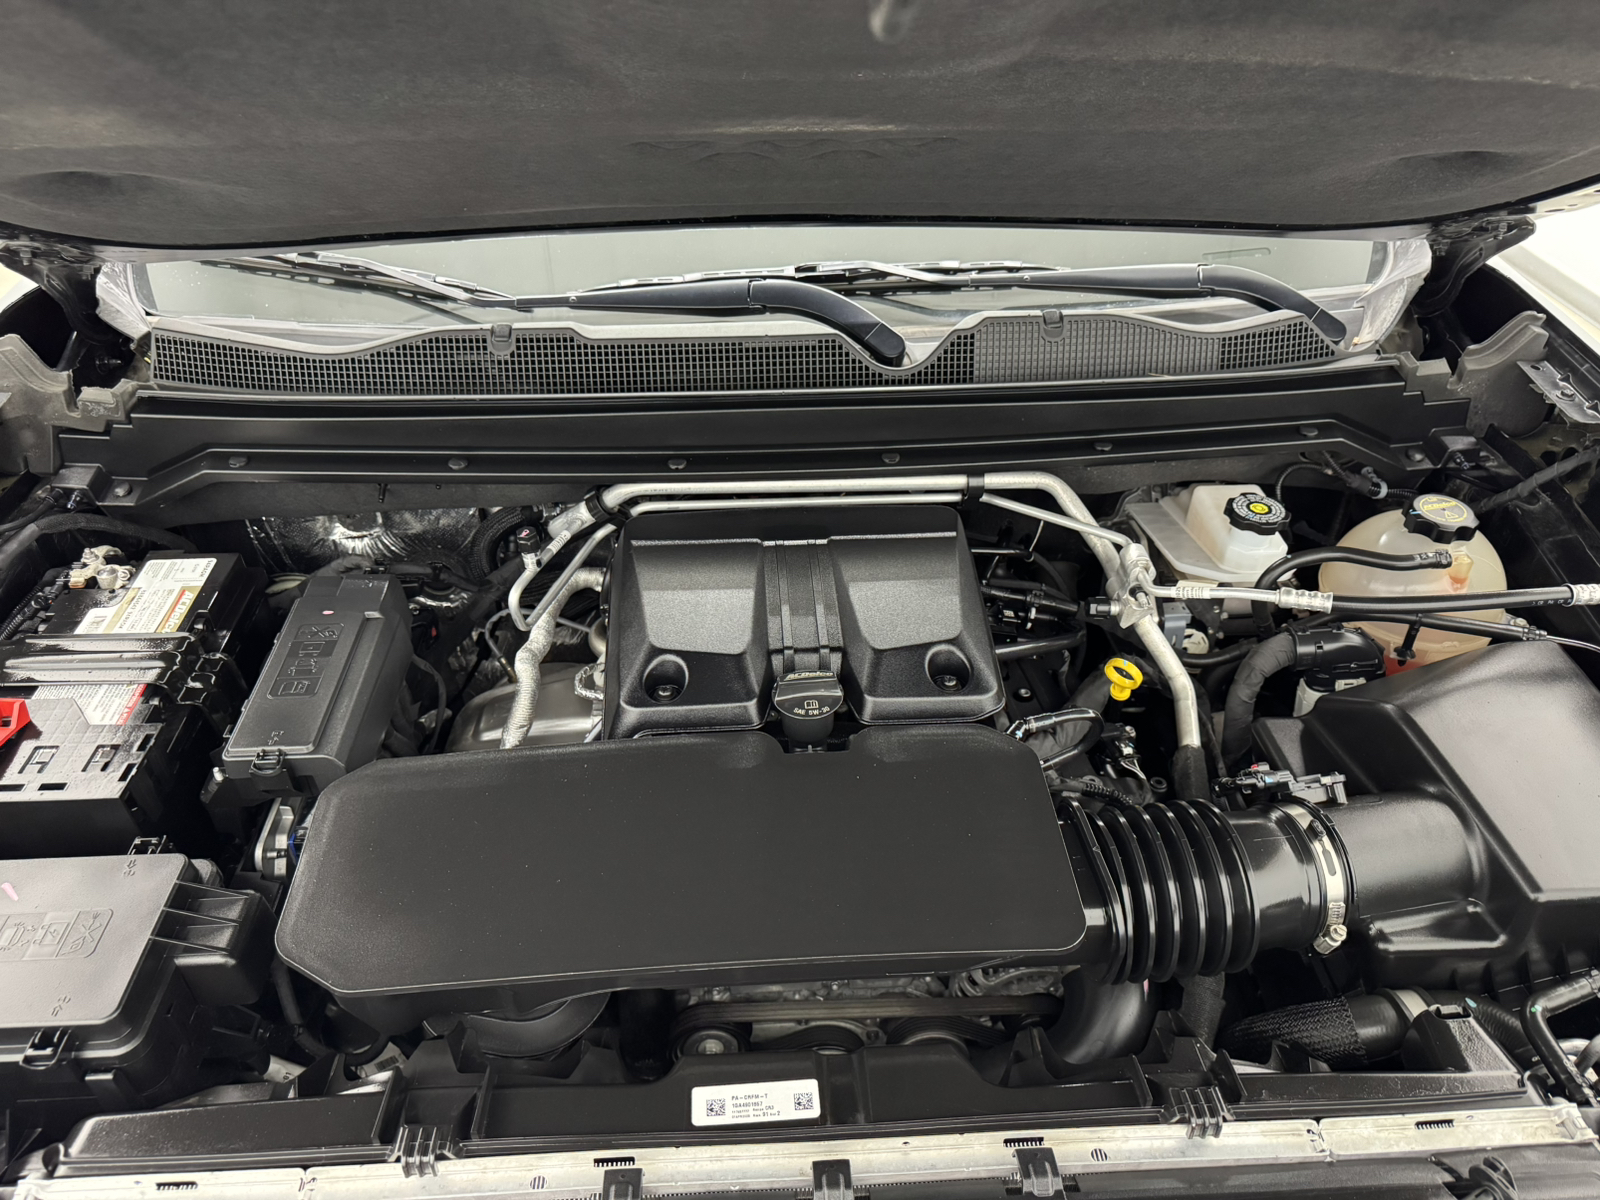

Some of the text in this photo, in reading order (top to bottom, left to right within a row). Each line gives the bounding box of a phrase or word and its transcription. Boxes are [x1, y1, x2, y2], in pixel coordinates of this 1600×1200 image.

[784, 671, 834, 681] ACDelco
[793, 706, 831, 716] SAE 5W-30
